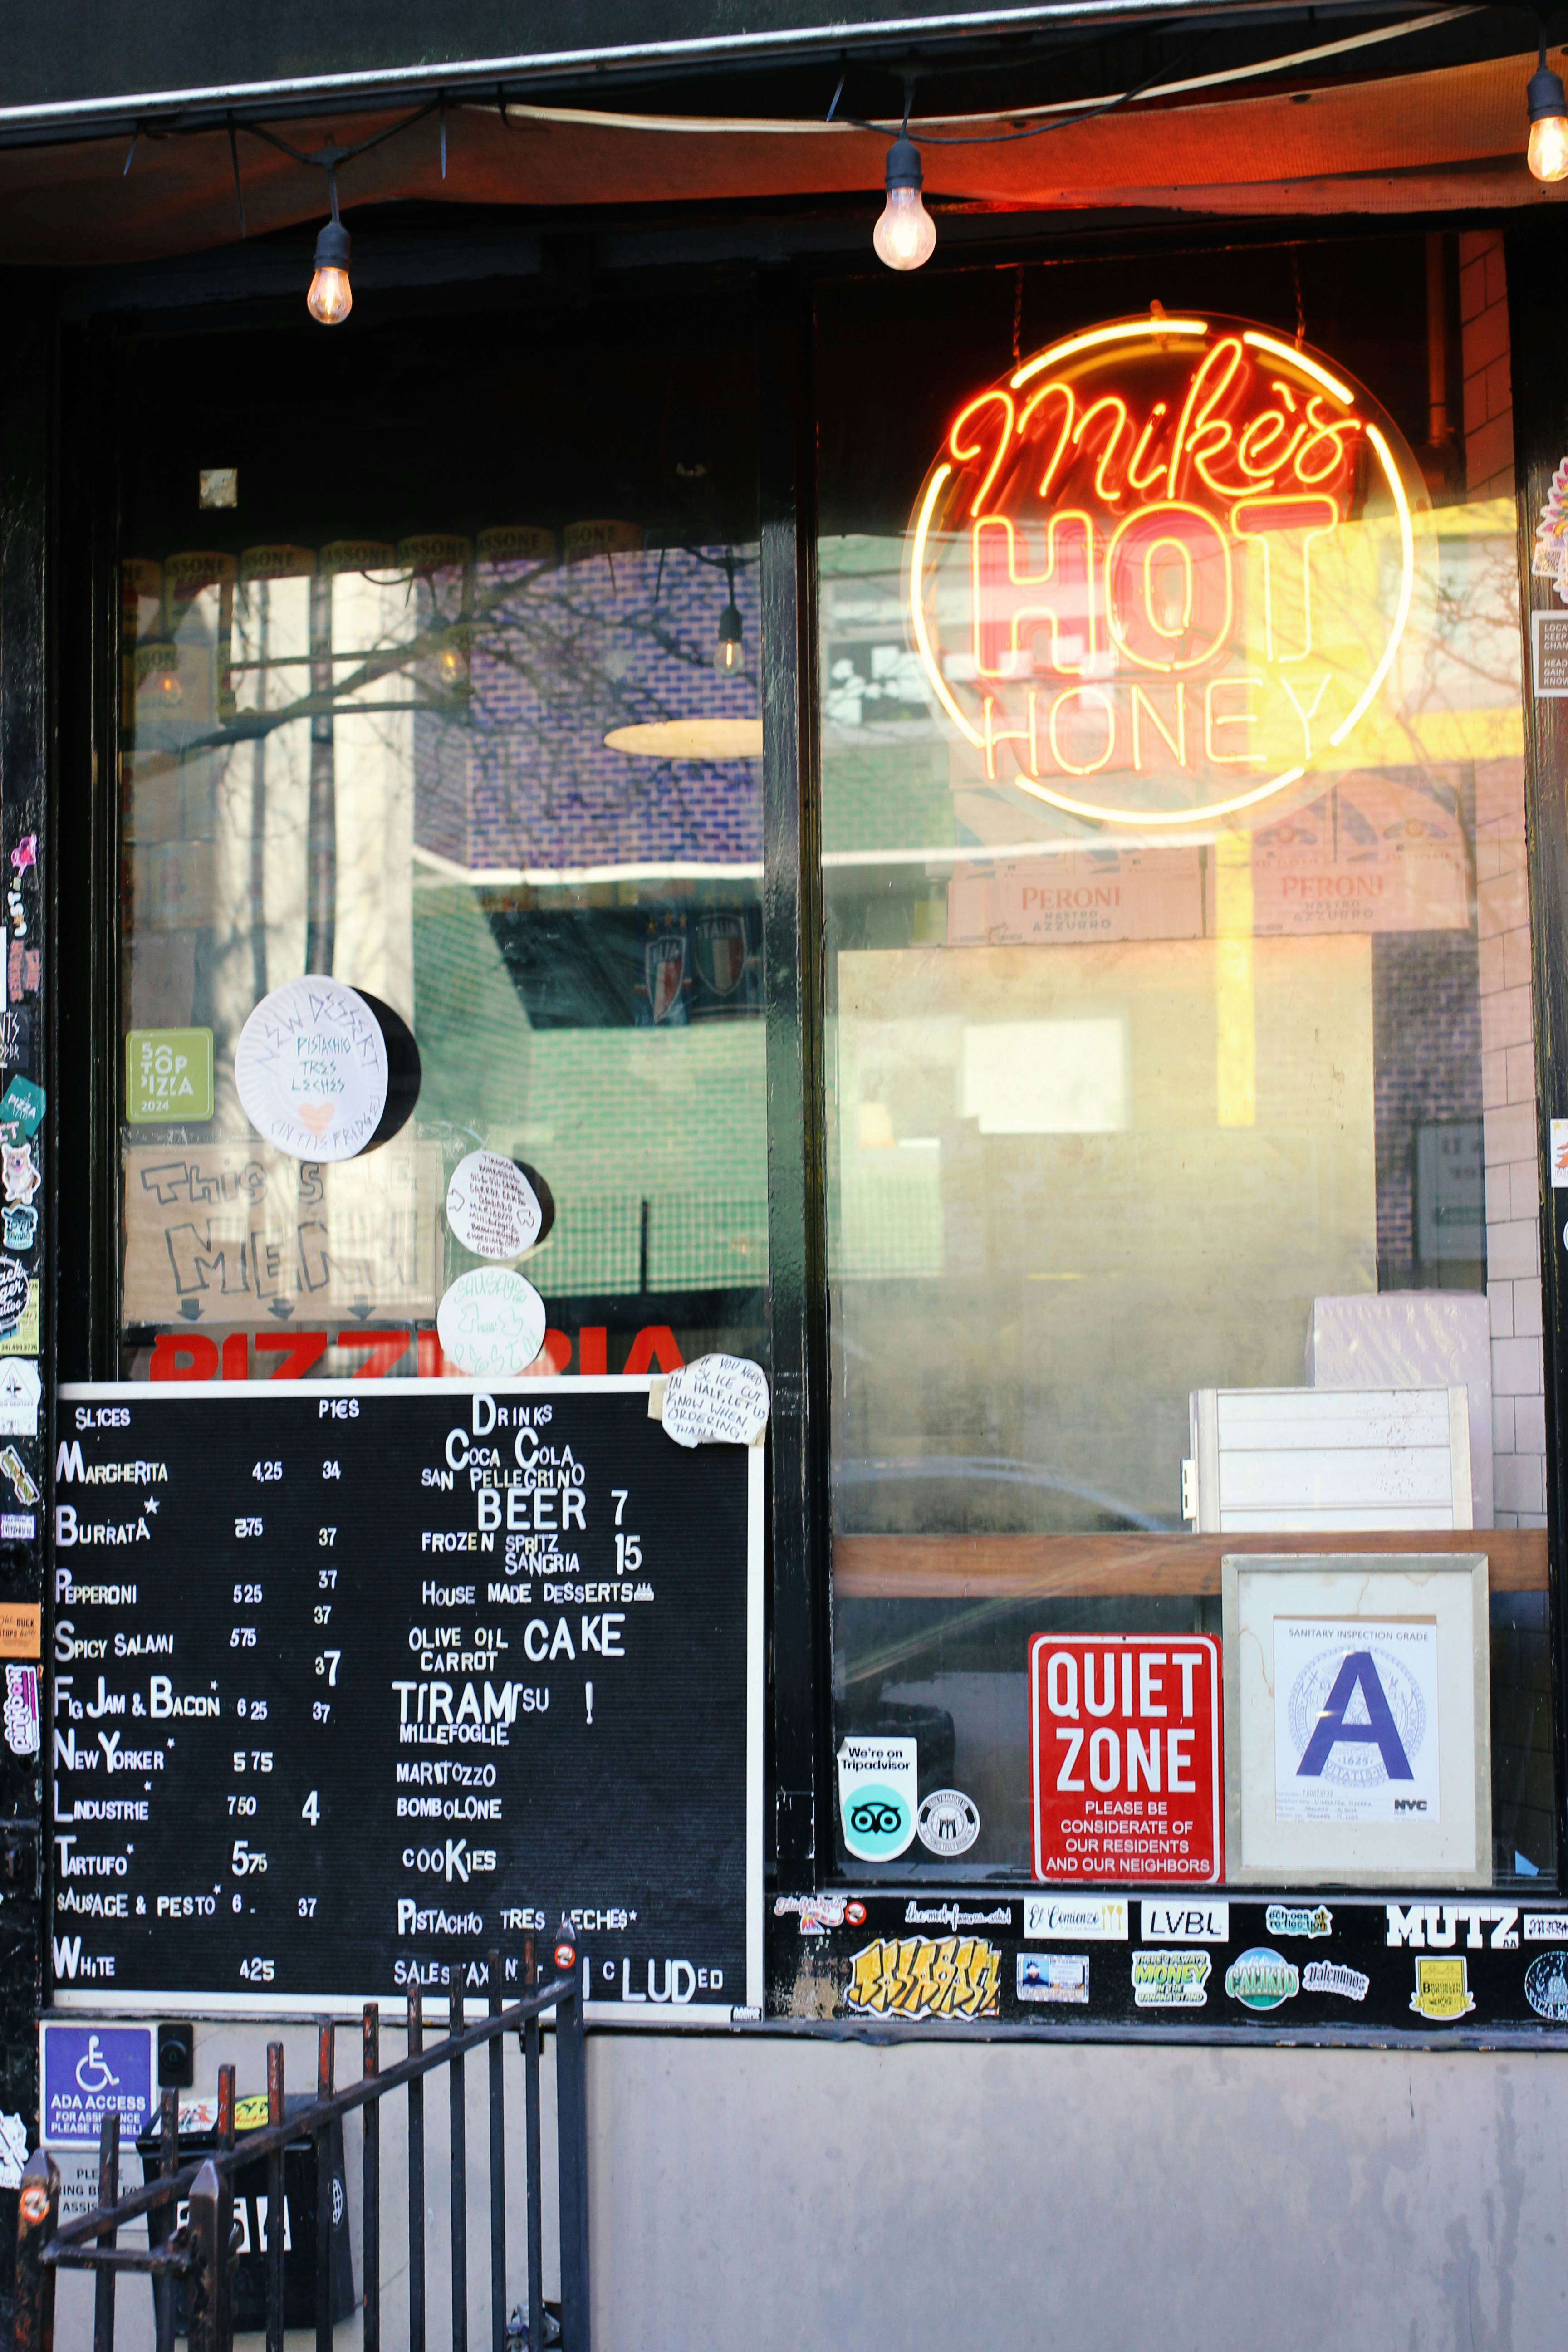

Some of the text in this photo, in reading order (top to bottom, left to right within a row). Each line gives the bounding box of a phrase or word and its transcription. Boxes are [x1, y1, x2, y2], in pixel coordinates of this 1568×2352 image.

[949, 337, 1362, 517] Mike's
[970, 493, 1338, 678] HOT
[1544, 624, 1568, 632] LOCA
[1544, 633, 1566, 641] KEEP
[1544, 668, 1564, 676] GAIN
[983, 671, 1334, 780] HONEY
[1022, 886, 1121, 911] PERONI
[1281, 875, 1383, 899] PERONI
[1033, 920, 1111, 932] AZZURRO
[1045, 910, 1098, 920] NASTRO
[1293, 910, 1374, 922] AZZURRO
[297, 1034, 352, 1056] PISTACHIO
[141, 1055, 187, 1074] TOP
[299, 1059, 336, 1075] TRES
[291, 1076, 345, 1095] LECHES
[142, 1099, 169, 1112] 2024
[165, 1210, 417, 1299] MENU
[669, 1376, 682, 1389] IN
[472, 1393, 552, 1436] DRINKS
[445, 1427, 575, 1471] COCA COLA
[56, 1441, 341, 1486] MARGHERITA 34
[421, 1468, 454, 1491] SAN
[478, 1488, 628, 1531] BEER 7
[56, 1504, 151, 1547] BURRATA
[319, 1527, 337, 1546] 37
[422, 1532, 642, 1575] FROZEN SPRITZ 15
[505, 1552, 580, 1577] SANGRIA
[55, 1568, 137, 1605] PEPPERONI
[319, 1570, 337, 1590] 37
[422, 1581, 634, 1606] HOUSE MADE DESSERTS
[55, 1620, 108, 1662] SPICY
[114, 1633, 174, 1657] SALAMI
[314, 1605, 331, 1624] 37
[408, 1613, 626, 1662] OLIVE OIL CAKE
[1289, 1628, 1429, 1642] SANITARY INSPECTION GRADE
[315, 1650, 341, 1687] 37
[420, 1650, 498, 1673] CARROT
[1047, 1651, 1202, 1720] QUIET
[54, 1675, 330, 1724] FIG JAM & BACON 37
[391, 1681, 549, 1725] TIRAMISU
[1296, 1651, 1414, 1780] A
[54, 1728, 164, 1774] NEW YORKER
[848, 1748, 903, 1758] We're on
[1056, 1727, 1196, 1793] ZONE
[842, 1758, 910, 1773] Tripadvisor
[302, 1790, 320, 1826] 4
[397, 1795, 502, 1821] BOMBOLONE
[1085, 1801, 1167, 1815] PLEASE BE
[1394, 1798, 1428, 1811] NYC
[1060, 1820, 1193, 1834] CONSIDERATE OF
[54, 1835, 268, 1878] TARTUFO 575
[1066, 1838, 1189, 1854] OUR RESIDENTS
[1046, 1857, 1210, 1873] AND OUR NEIGHBORS
[57, 1885, 317, 1918] SAUSAGE & PESTO 37
[500, 1908, 545, 1931] TRES
[1029, 1904, 1099, 1930] El Comienzo
[1150, 1911, 1222, 1935] LVBL
[1387, 1905, 1519, 1949] MUTZ
[53, 1936, 275, 1982] WHITE 425
[1172, 1953, 1206, 1964] ALWAYS
[394, 1960, 489, 1989] SALES AX
[1135, 1963, 1208, 1984] MONEY
[1138, 1993, 1204, 2002] BANANA STAND
[1156, 1984, 1184, 1993] IN THE
[51, 2094, 145, 2111] ADA ACCESS
[51, 2122, 90, 2134] PLEASE
[56, 2111, 76, 2122] FOR
